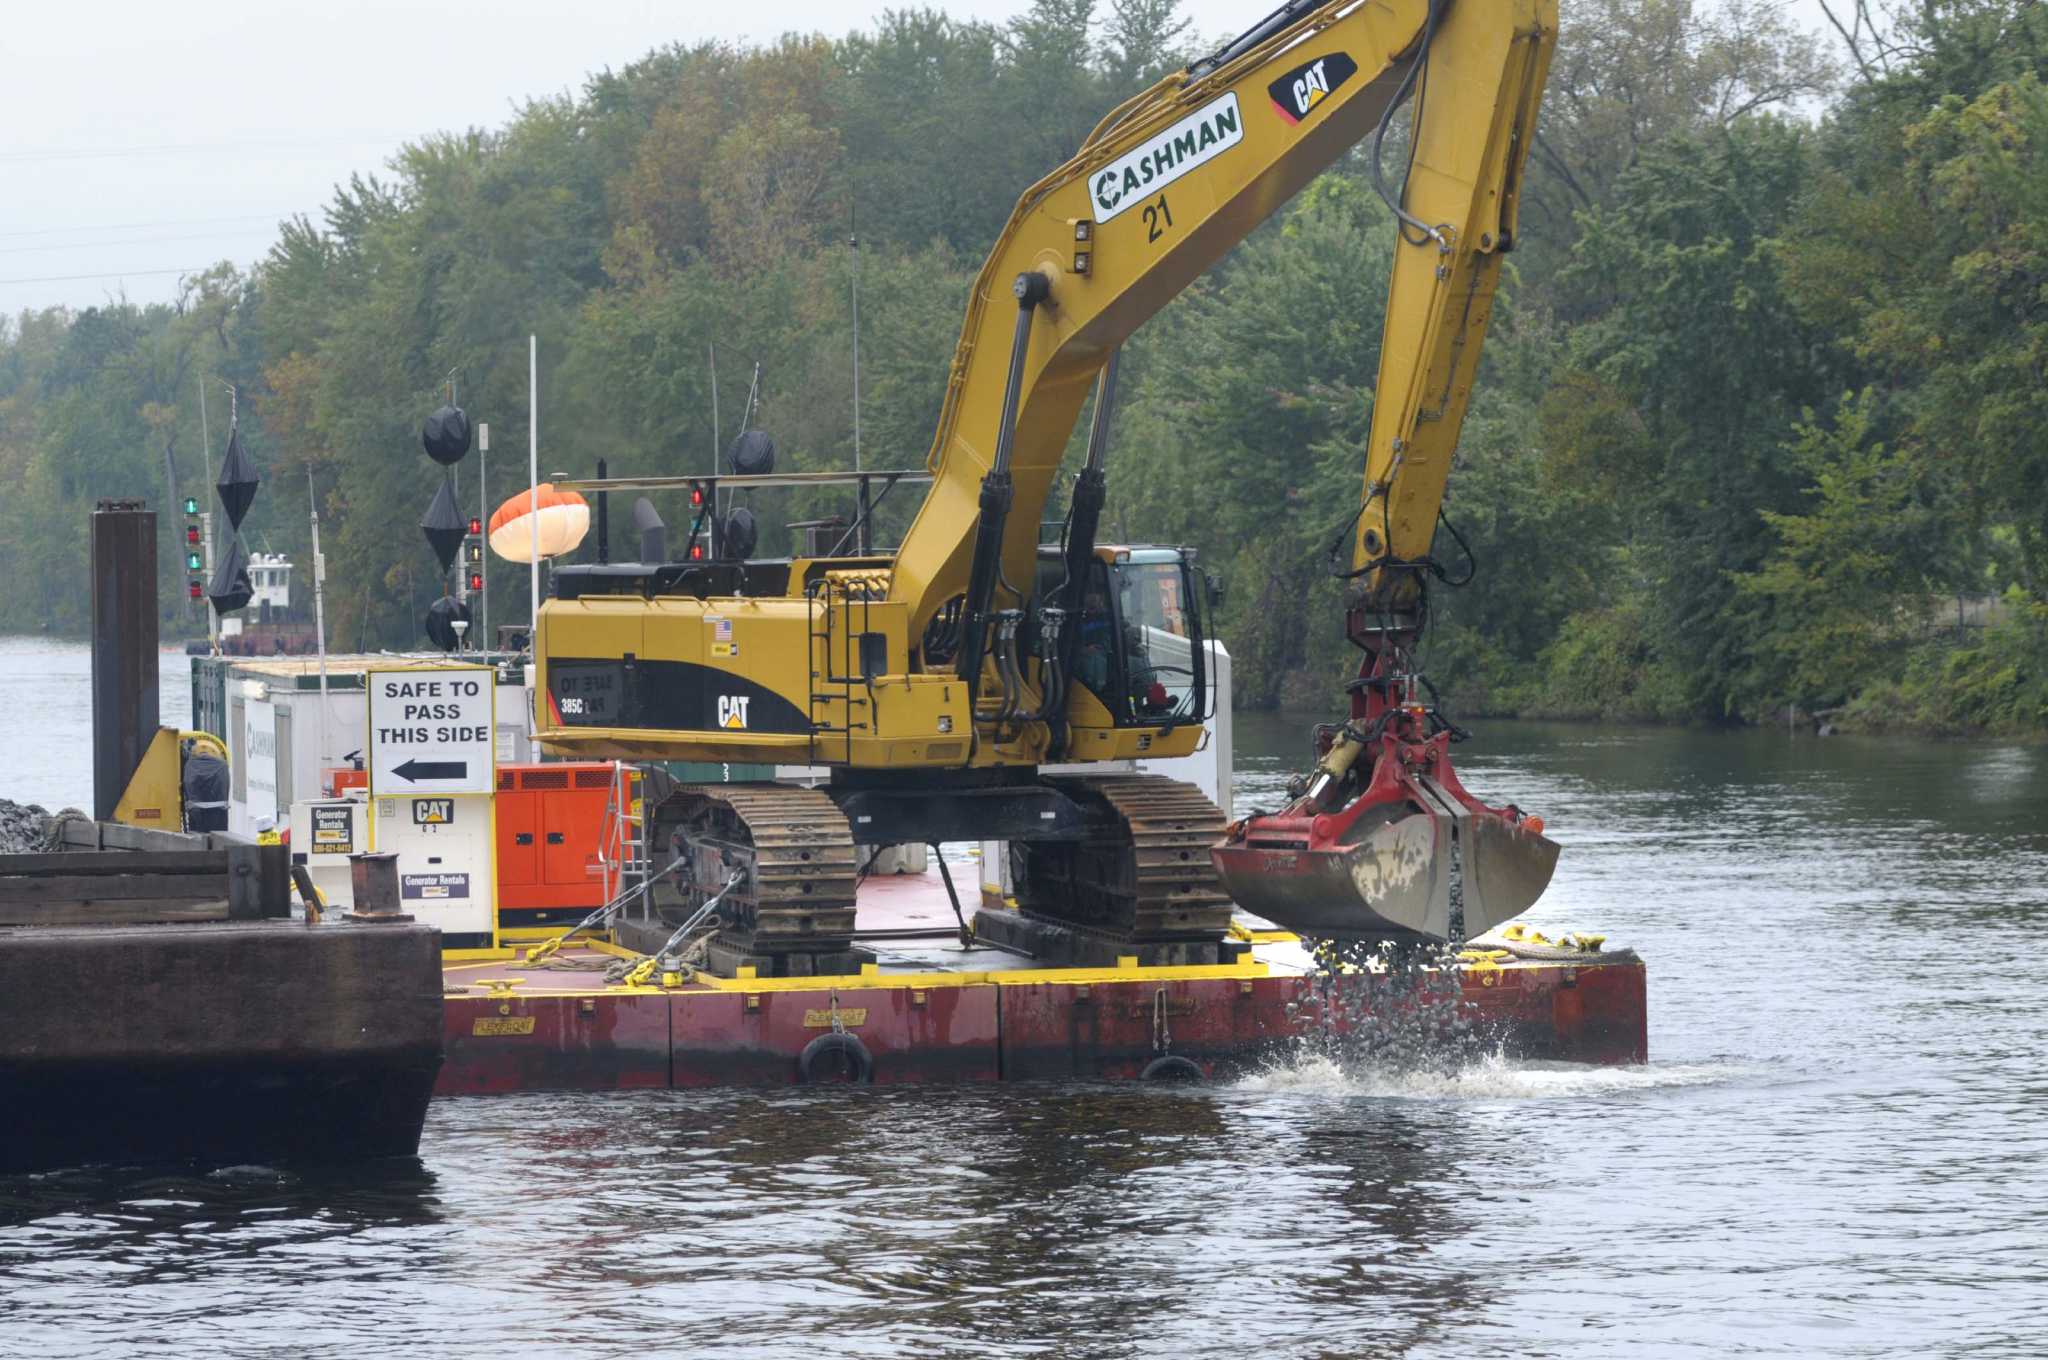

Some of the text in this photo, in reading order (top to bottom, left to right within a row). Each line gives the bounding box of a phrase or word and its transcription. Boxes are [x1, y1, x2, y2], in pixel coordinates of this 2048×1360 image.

[1293, 60, 1329, 114] CAT
[1096, 106, 1237, 210] CASHMAN
[1142, 194, 1173, 244] 21
[385, 681, 479, 698] SAFE TO
[405, 704, 461, 720] PASS
[561, 698, 583, 713] 385C
[718, 695, 750, 728] CAT
[378, 726, 488, 744] THIS SIDE
[416, 801, 450, 822] CAT
[405, 874, 465, 886] Generator Rentals
